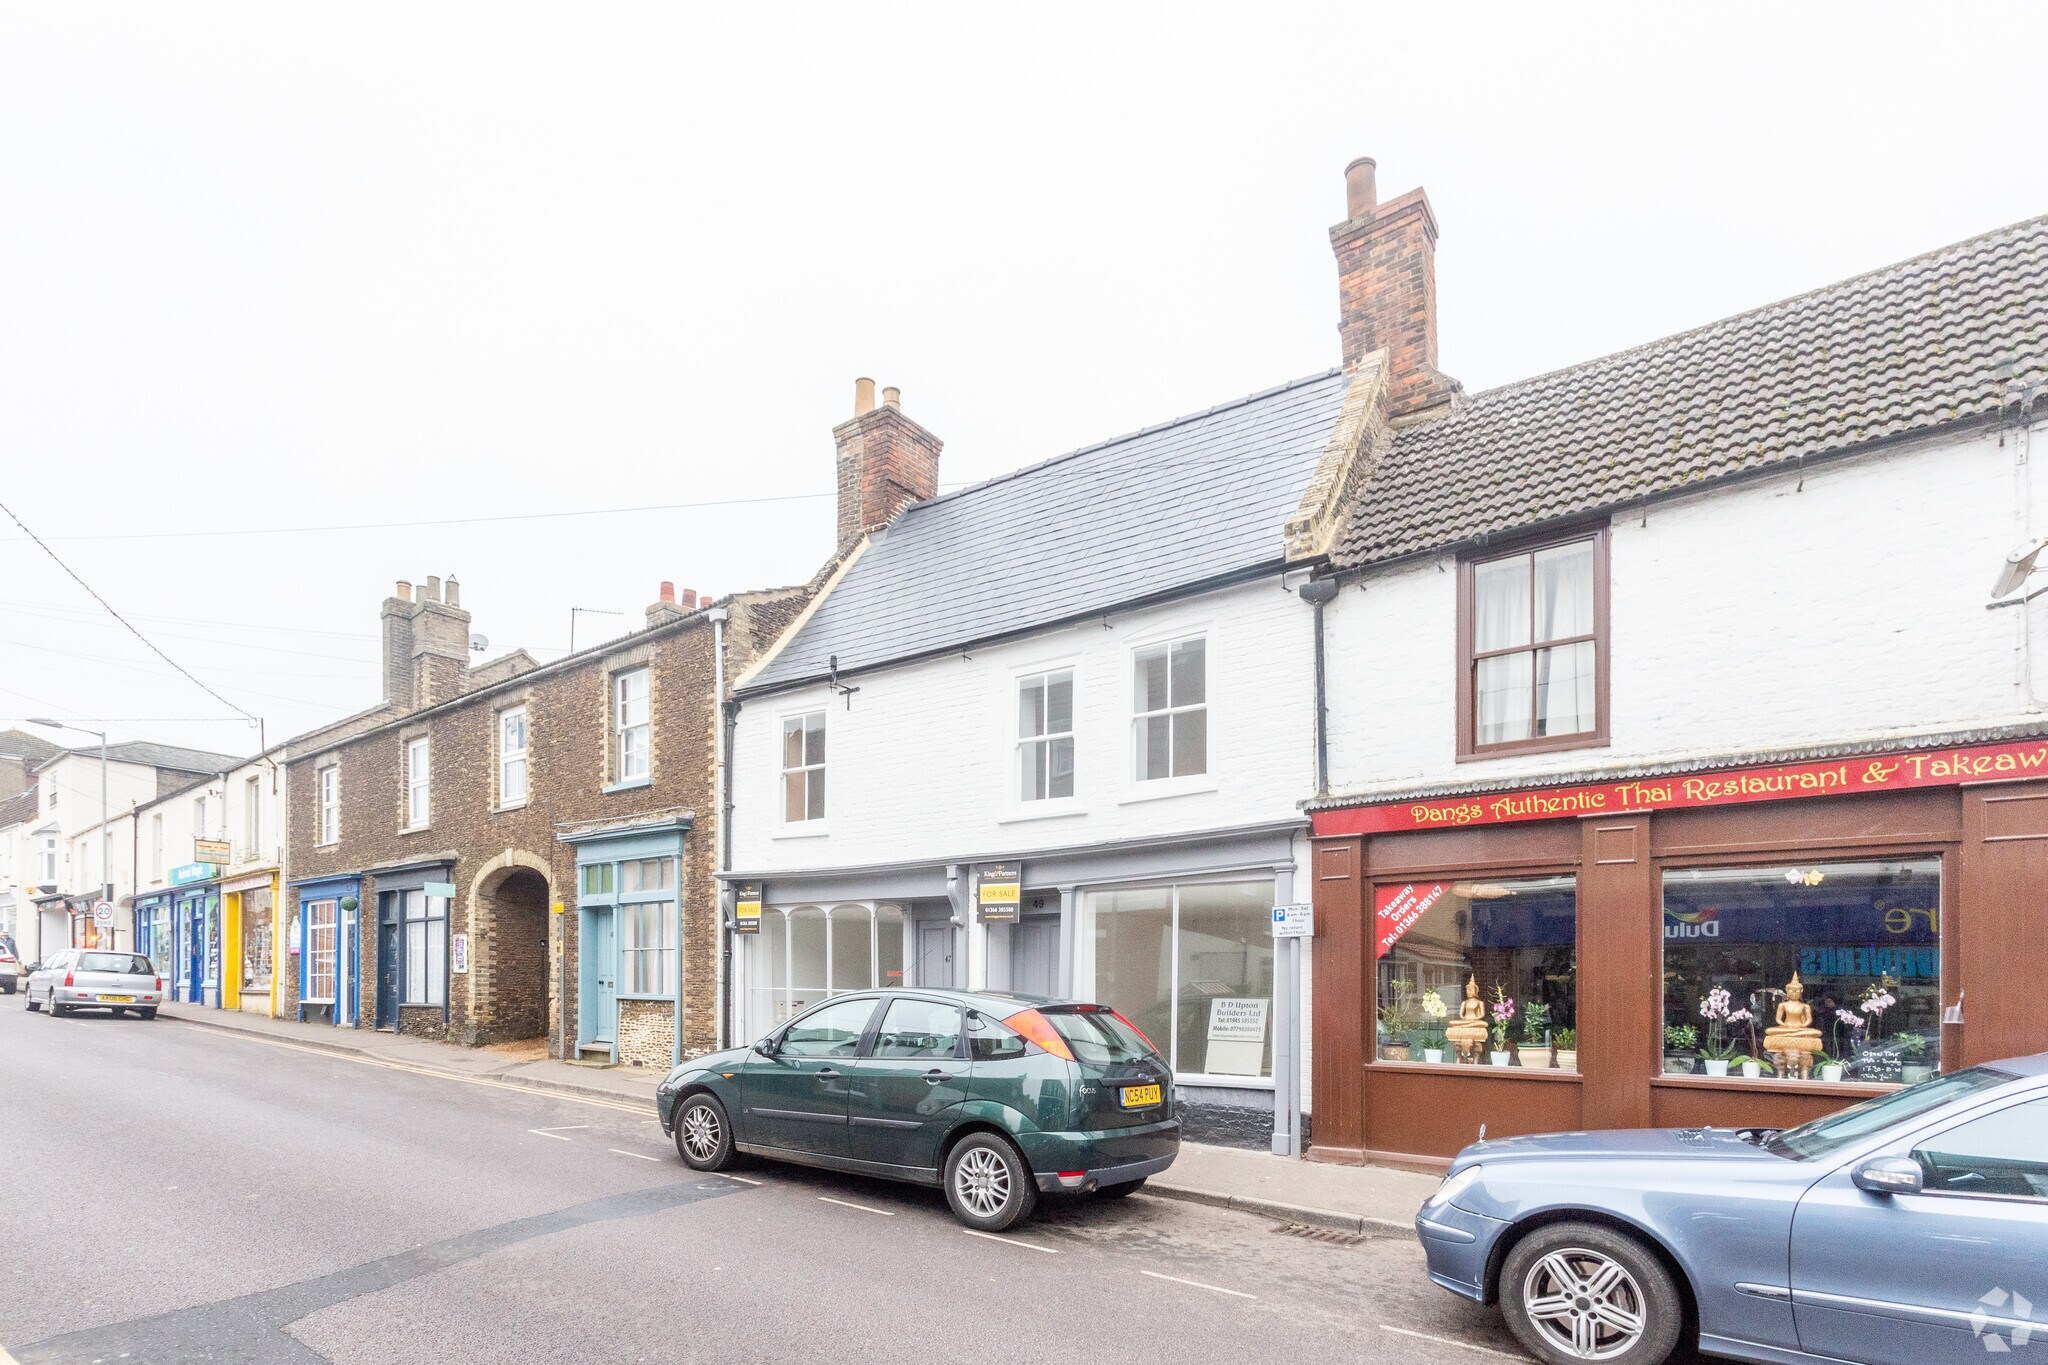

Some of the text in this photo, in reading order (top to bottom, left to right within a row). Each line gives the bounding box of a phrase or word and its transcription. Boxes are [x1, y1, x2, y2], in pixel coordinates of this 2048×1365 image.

[1410, 801, 1482, 824] Dangs
[1490, 791, 1606, 819] Authentic
[1614, 782, 1672, 806] Thai
[1682, 765, 1848, 801] Restaurant
[1861, 761, 1899, 784] &
[982, 889, 1016, 898] FOR SALE
[1378, 884, 1414, 919] Takeaway
[98, 907, 110, 915] 20
[1033, 899, 1045, 909] 49
[1390, 896, 1417, 922] Orders
[1381, 885, 1443, 946] Tel: 01366 388147
[1235, 1001, 1259, 1009] Upton
[1124, 1086, 1159, 1103] NC54 PUY
